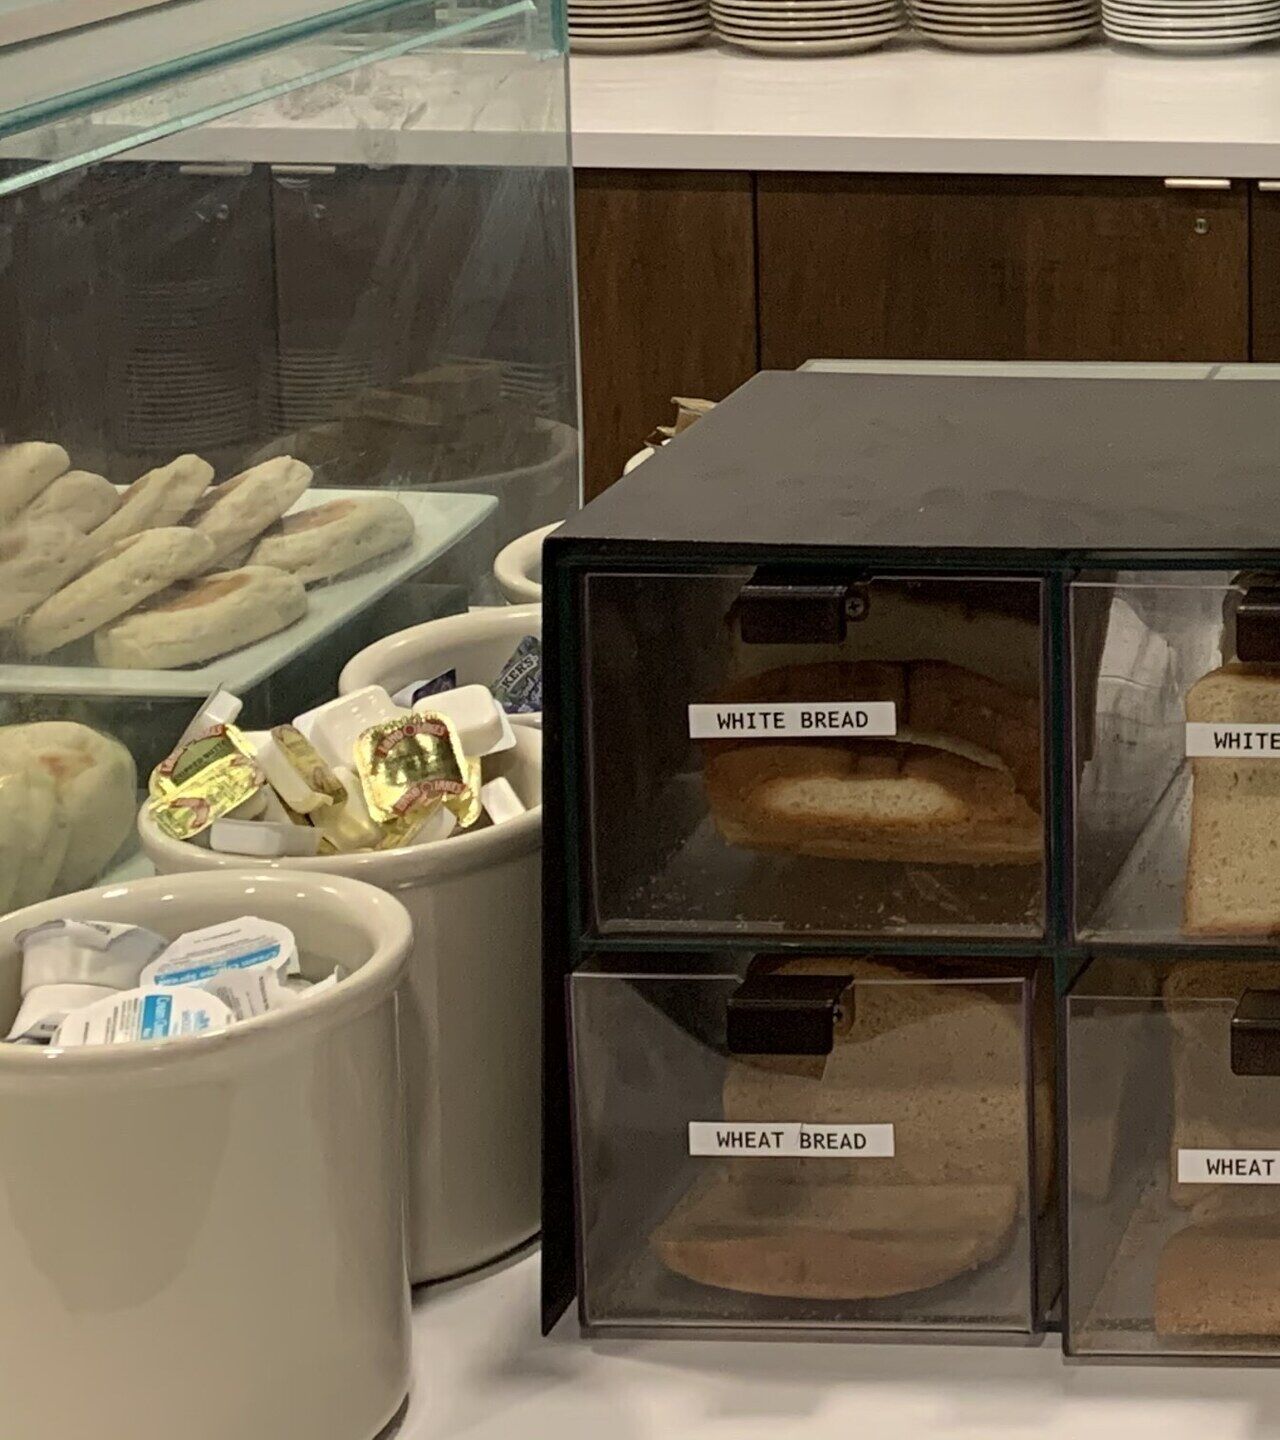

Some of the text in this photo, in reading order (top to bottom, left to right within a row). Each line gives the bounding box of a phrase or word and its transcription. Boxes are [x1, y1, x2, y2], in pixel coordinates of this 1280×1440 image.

[717, 711, 868, 729] WHITE BREAD
[717, 1131, 866, 1149] WHEAT BREAD
[1206, 1158, 1275, 1176] WHEAT
